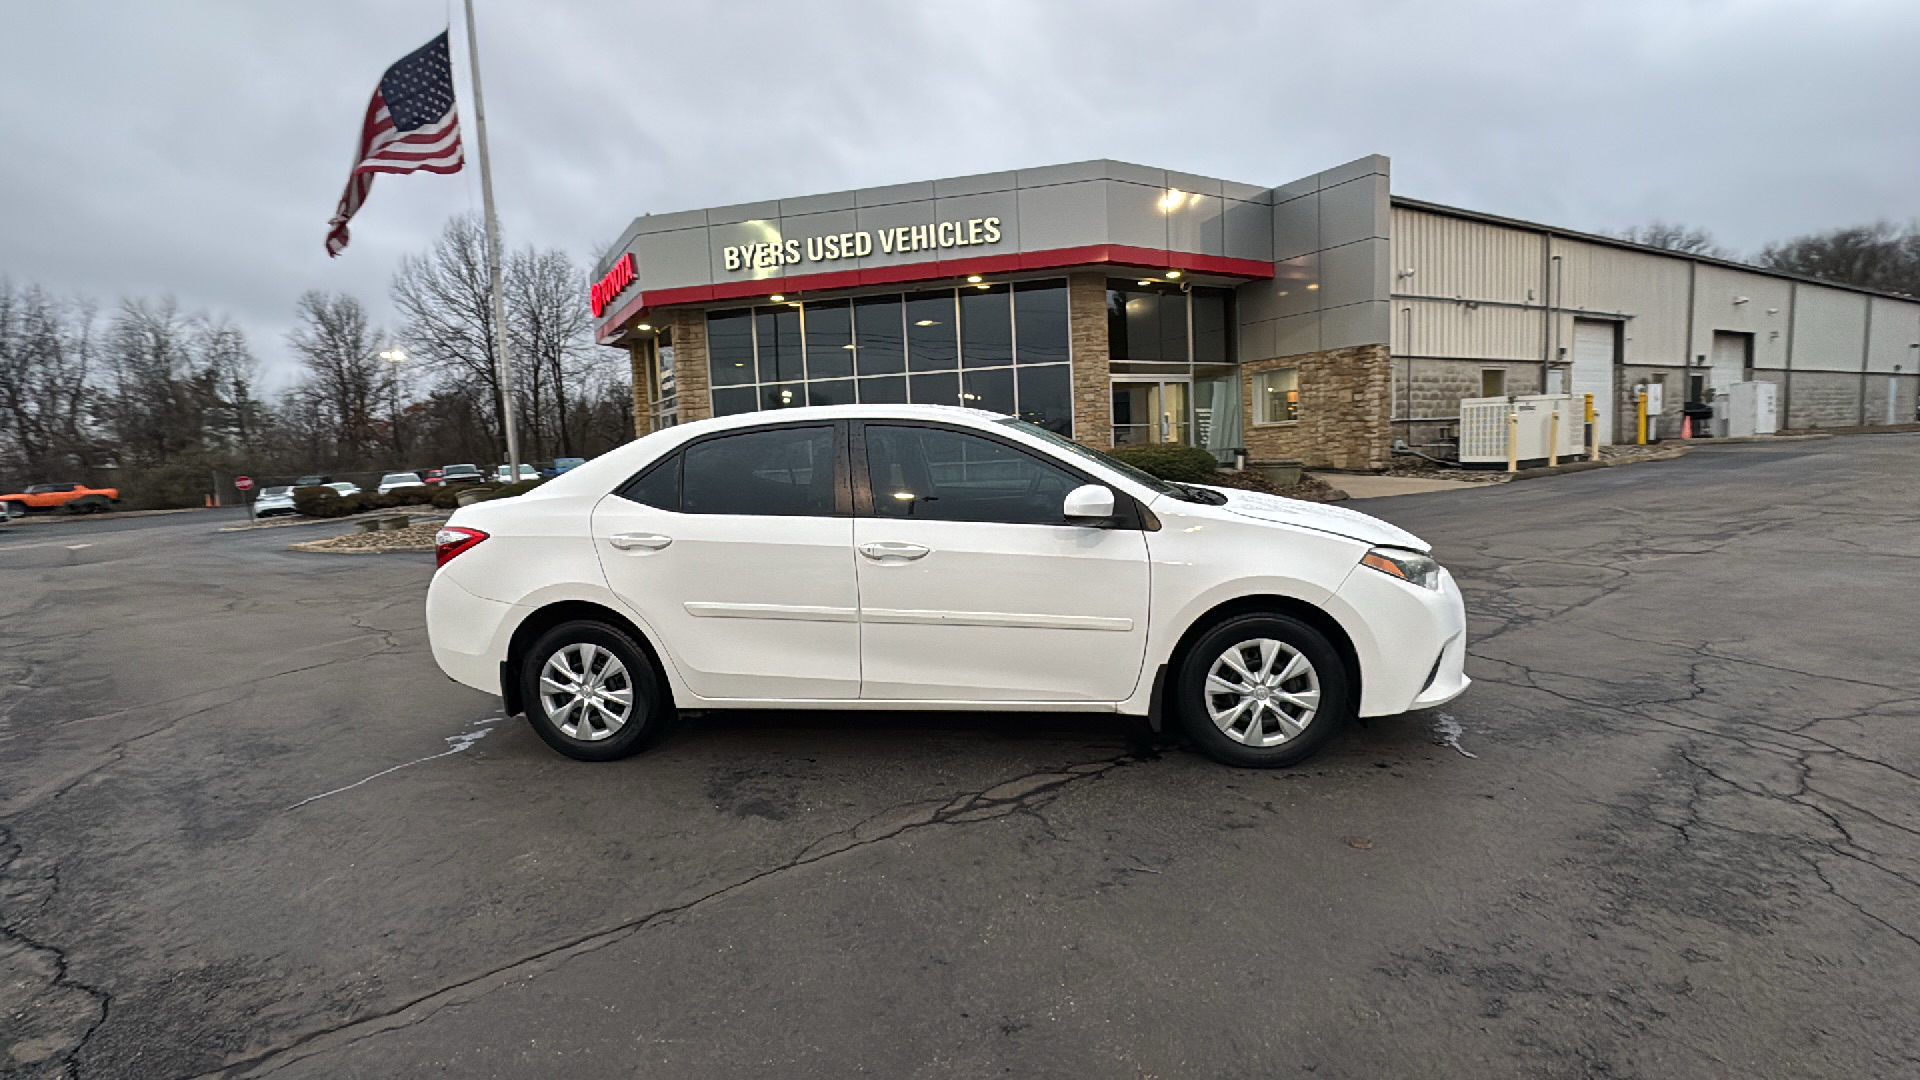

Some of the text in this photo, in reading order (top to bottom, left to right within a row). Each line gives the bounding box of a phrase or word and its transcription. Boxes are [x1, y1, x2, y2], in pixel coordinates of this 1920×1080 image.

[723, 217, 1001, 270] BYERS USED VEHICLES
[599, 253, 633, 306] TOYOTA
